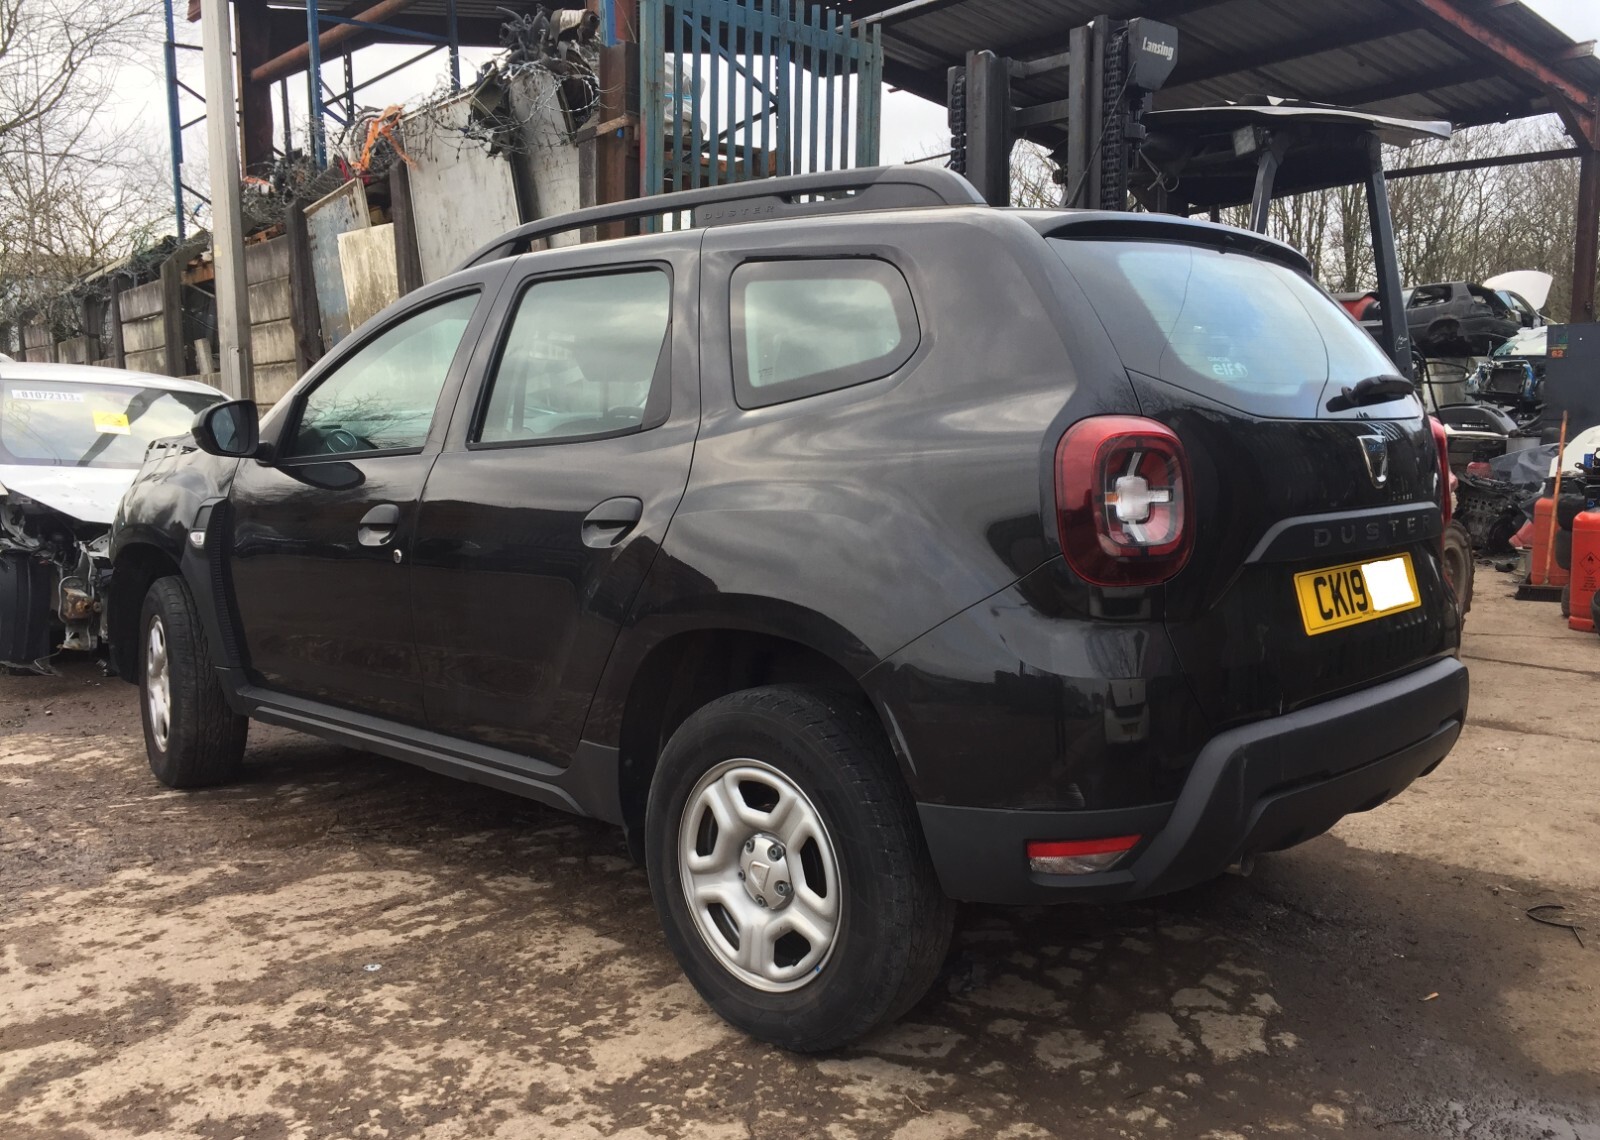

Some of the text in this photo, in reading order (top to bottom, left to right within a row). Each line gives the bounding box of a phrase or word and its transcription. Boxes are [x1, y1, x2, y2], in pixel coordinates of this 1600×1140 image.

[1142, 36, 1174, 60] Lansing
[704, 206, 774, 220] DUSTER
[1313, 514, 1432, 548] DUSTER
[1313, 569, 1368, 621] CK19
